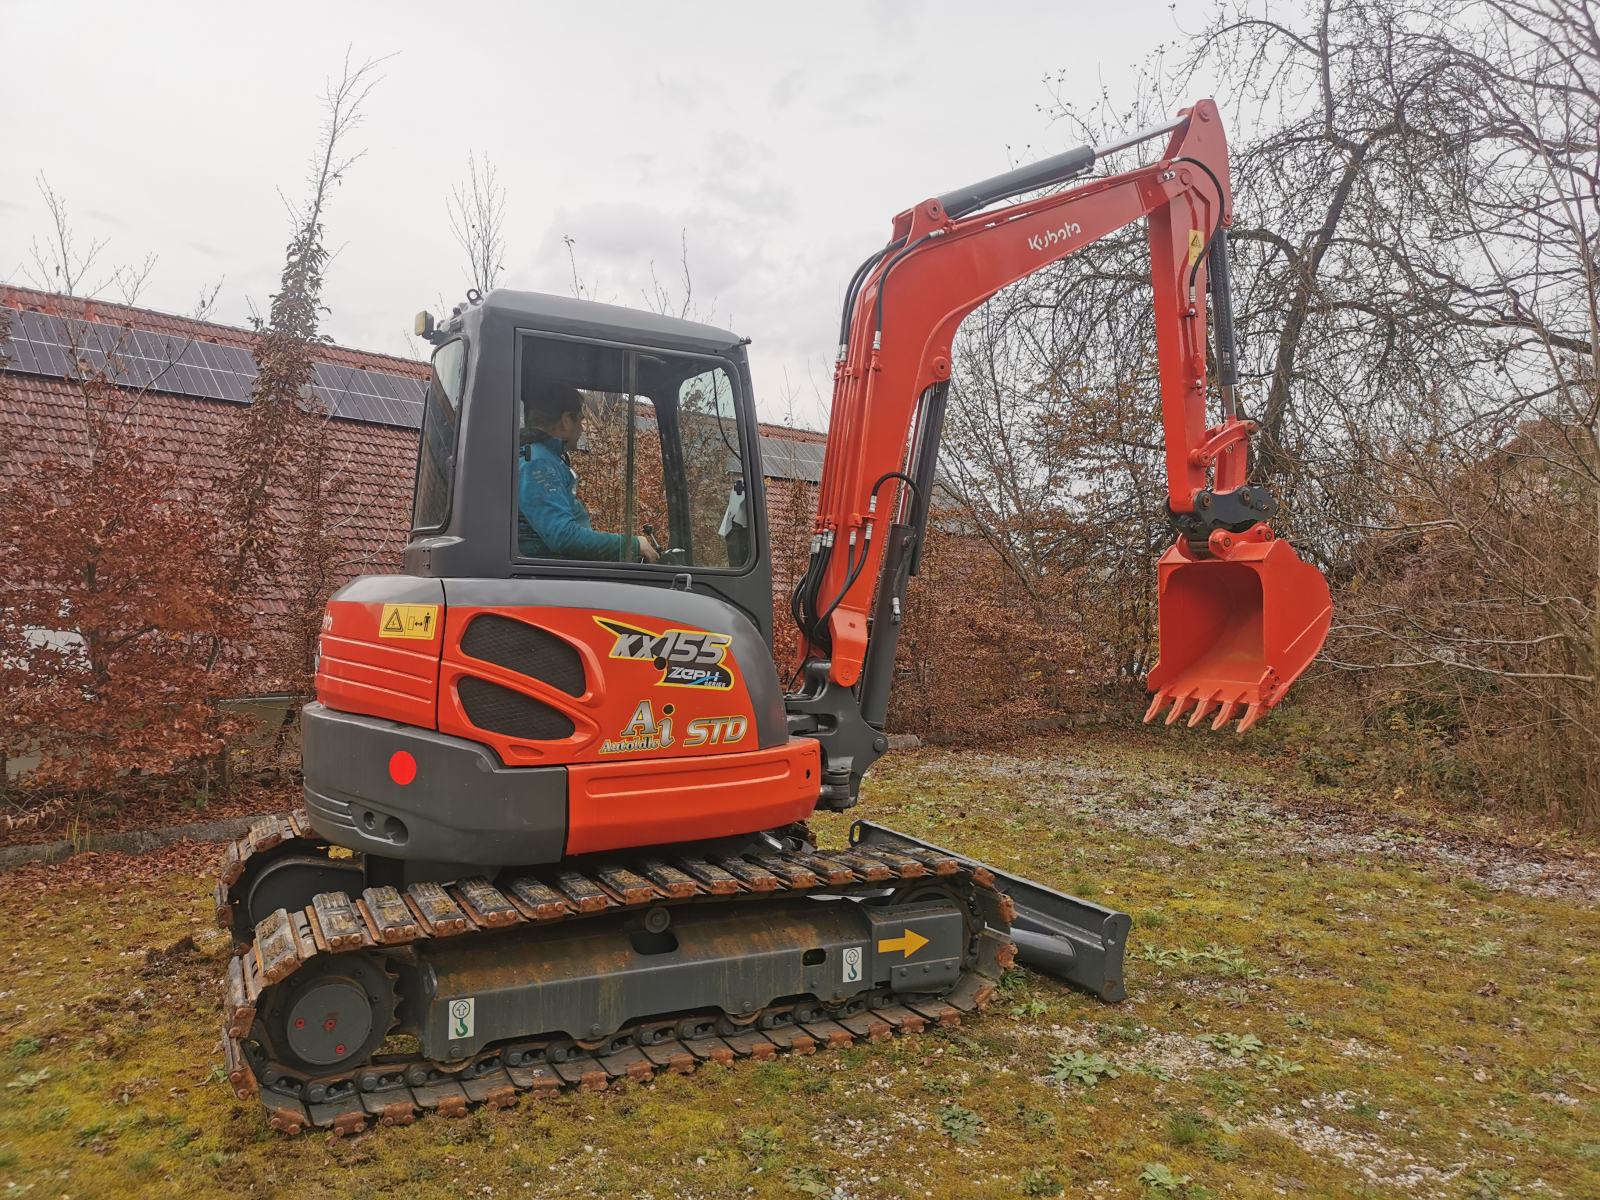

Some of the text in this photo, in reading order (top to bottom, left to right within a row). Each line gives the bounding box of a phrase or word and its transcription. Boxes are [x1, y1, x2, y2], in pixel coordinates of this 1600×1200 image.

[1028, 222, 1081, 251] Kubota
[621, 700, 747, 748] Ai STD
